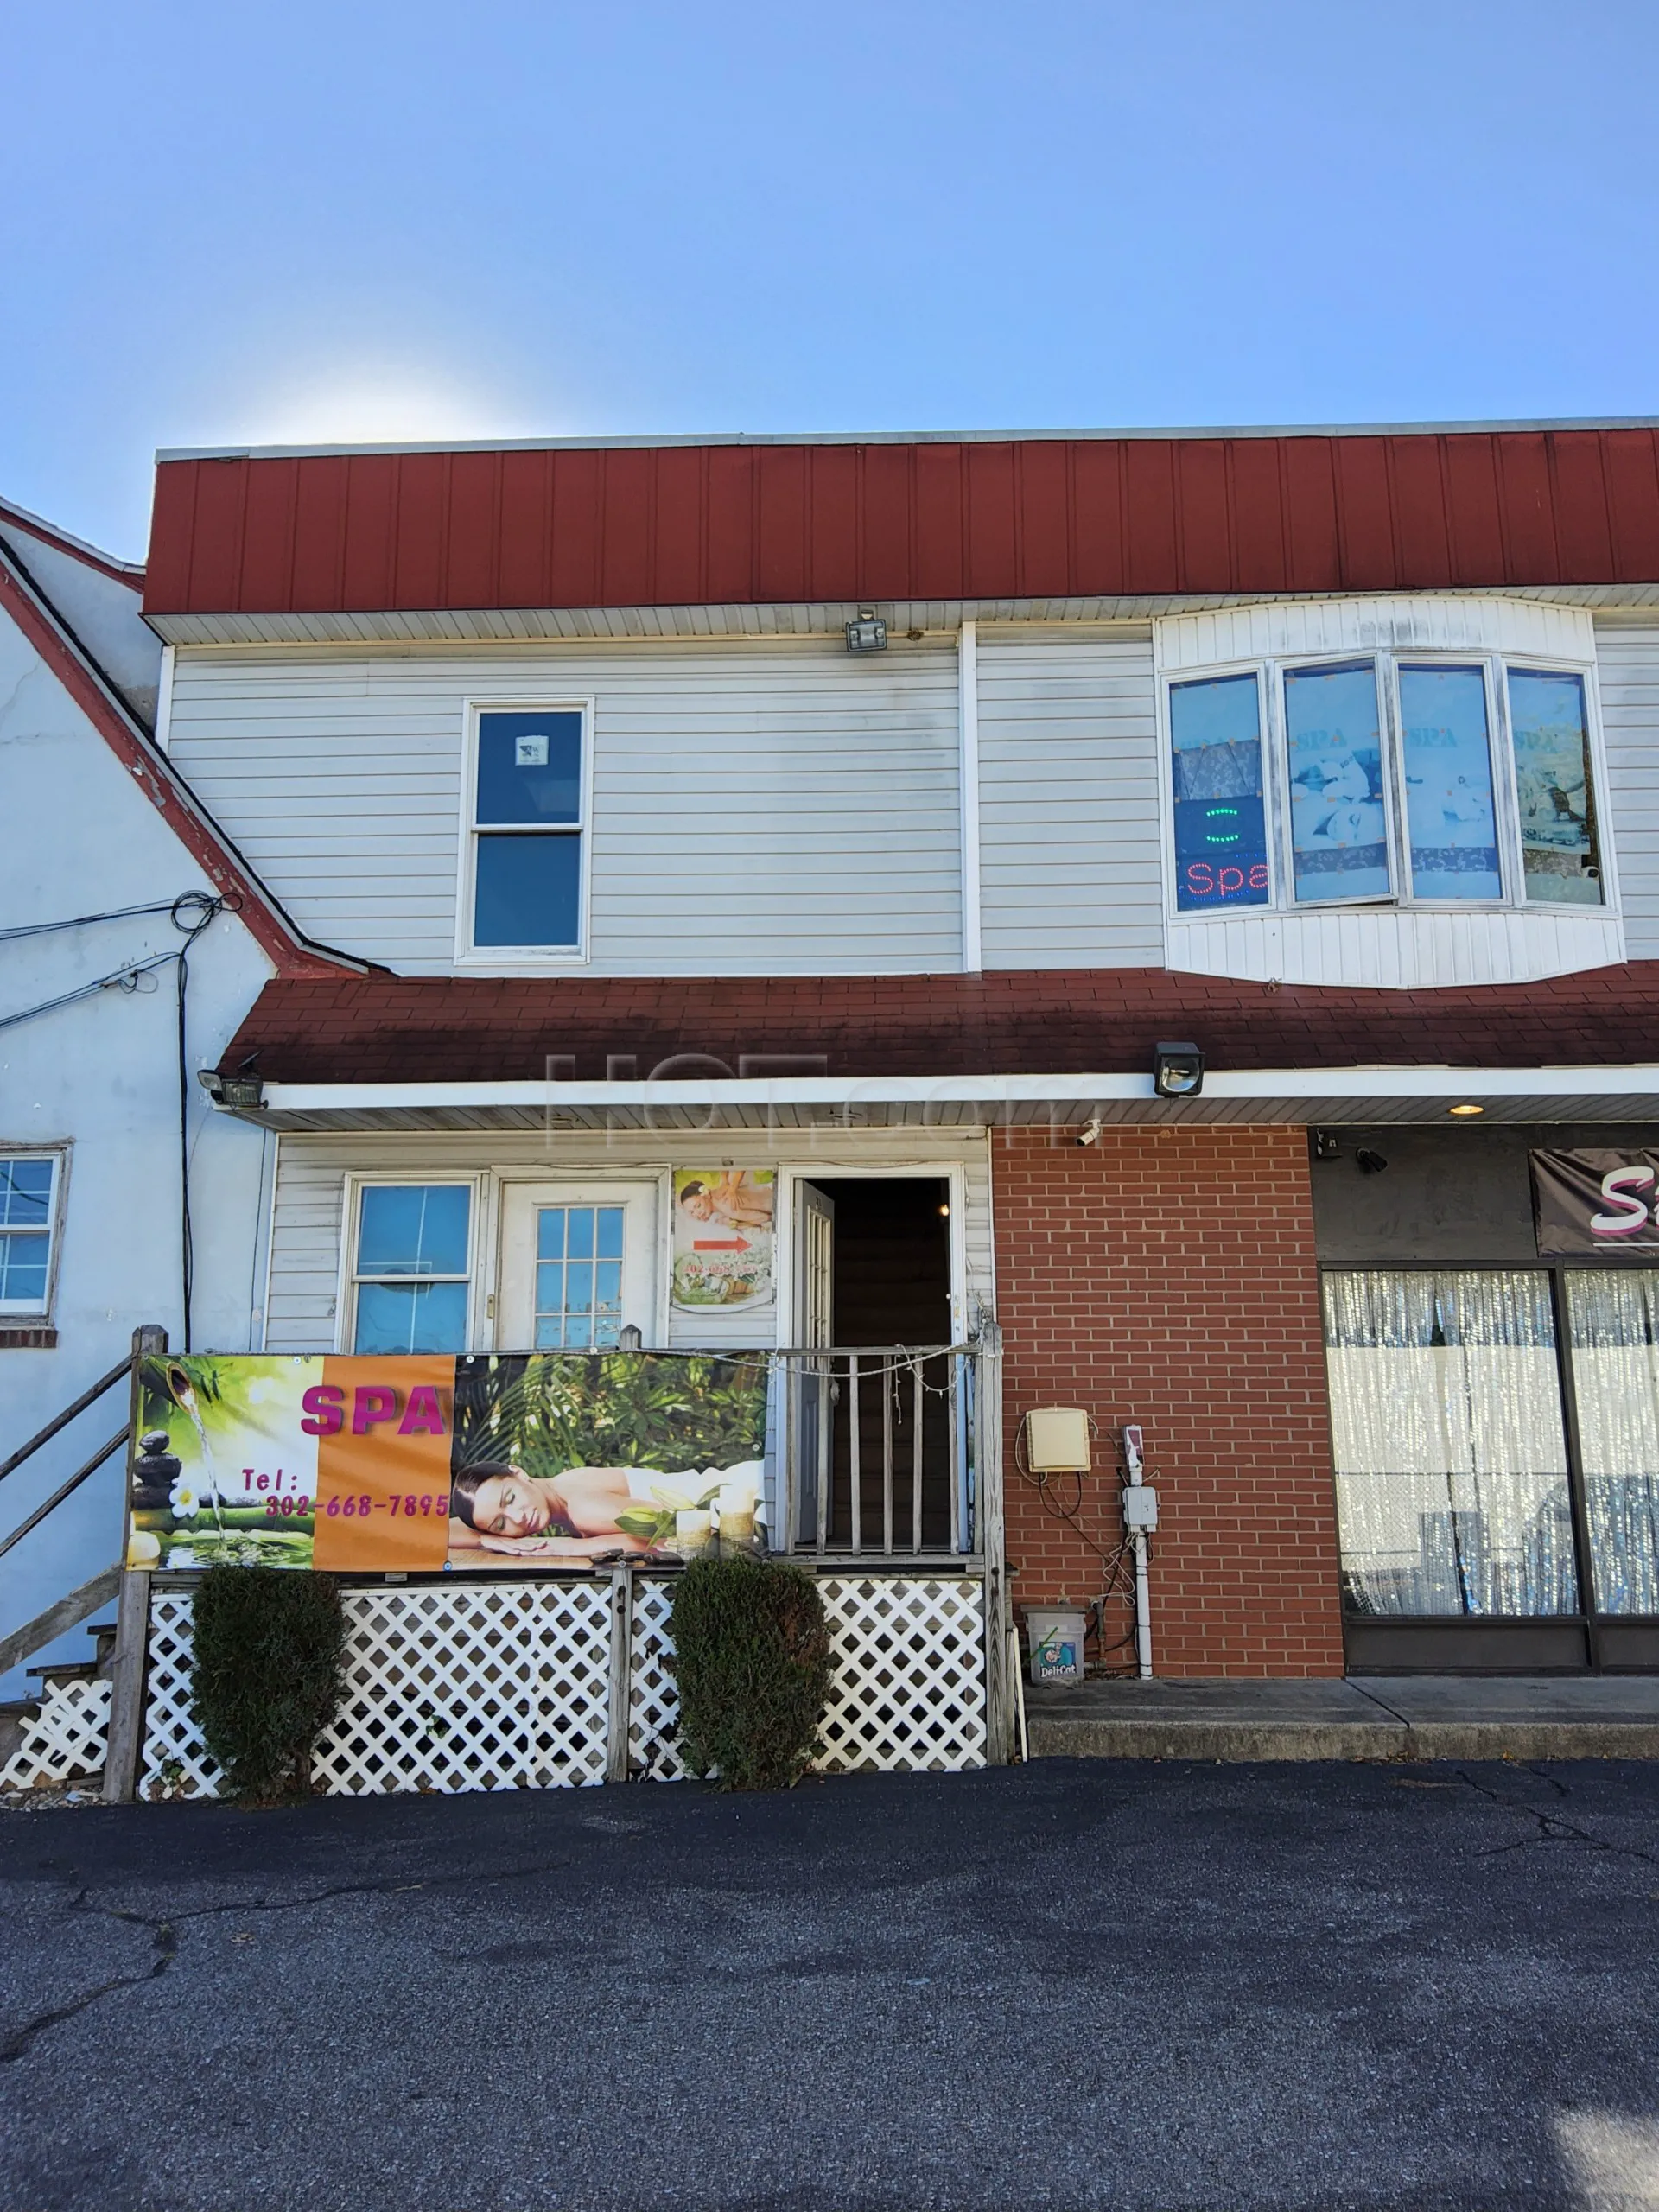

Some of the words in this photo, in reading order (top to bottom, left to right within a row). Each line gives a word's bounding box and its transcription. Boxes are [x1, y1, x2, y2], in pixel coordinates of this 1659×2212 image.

[1590, 1166, 1659, 1236] S
[301, 1385, 446, 1435] SPA
[242, 1469, 297, 1491] Tel:
[265, 1495, 449, 1516] 302-668-7895
